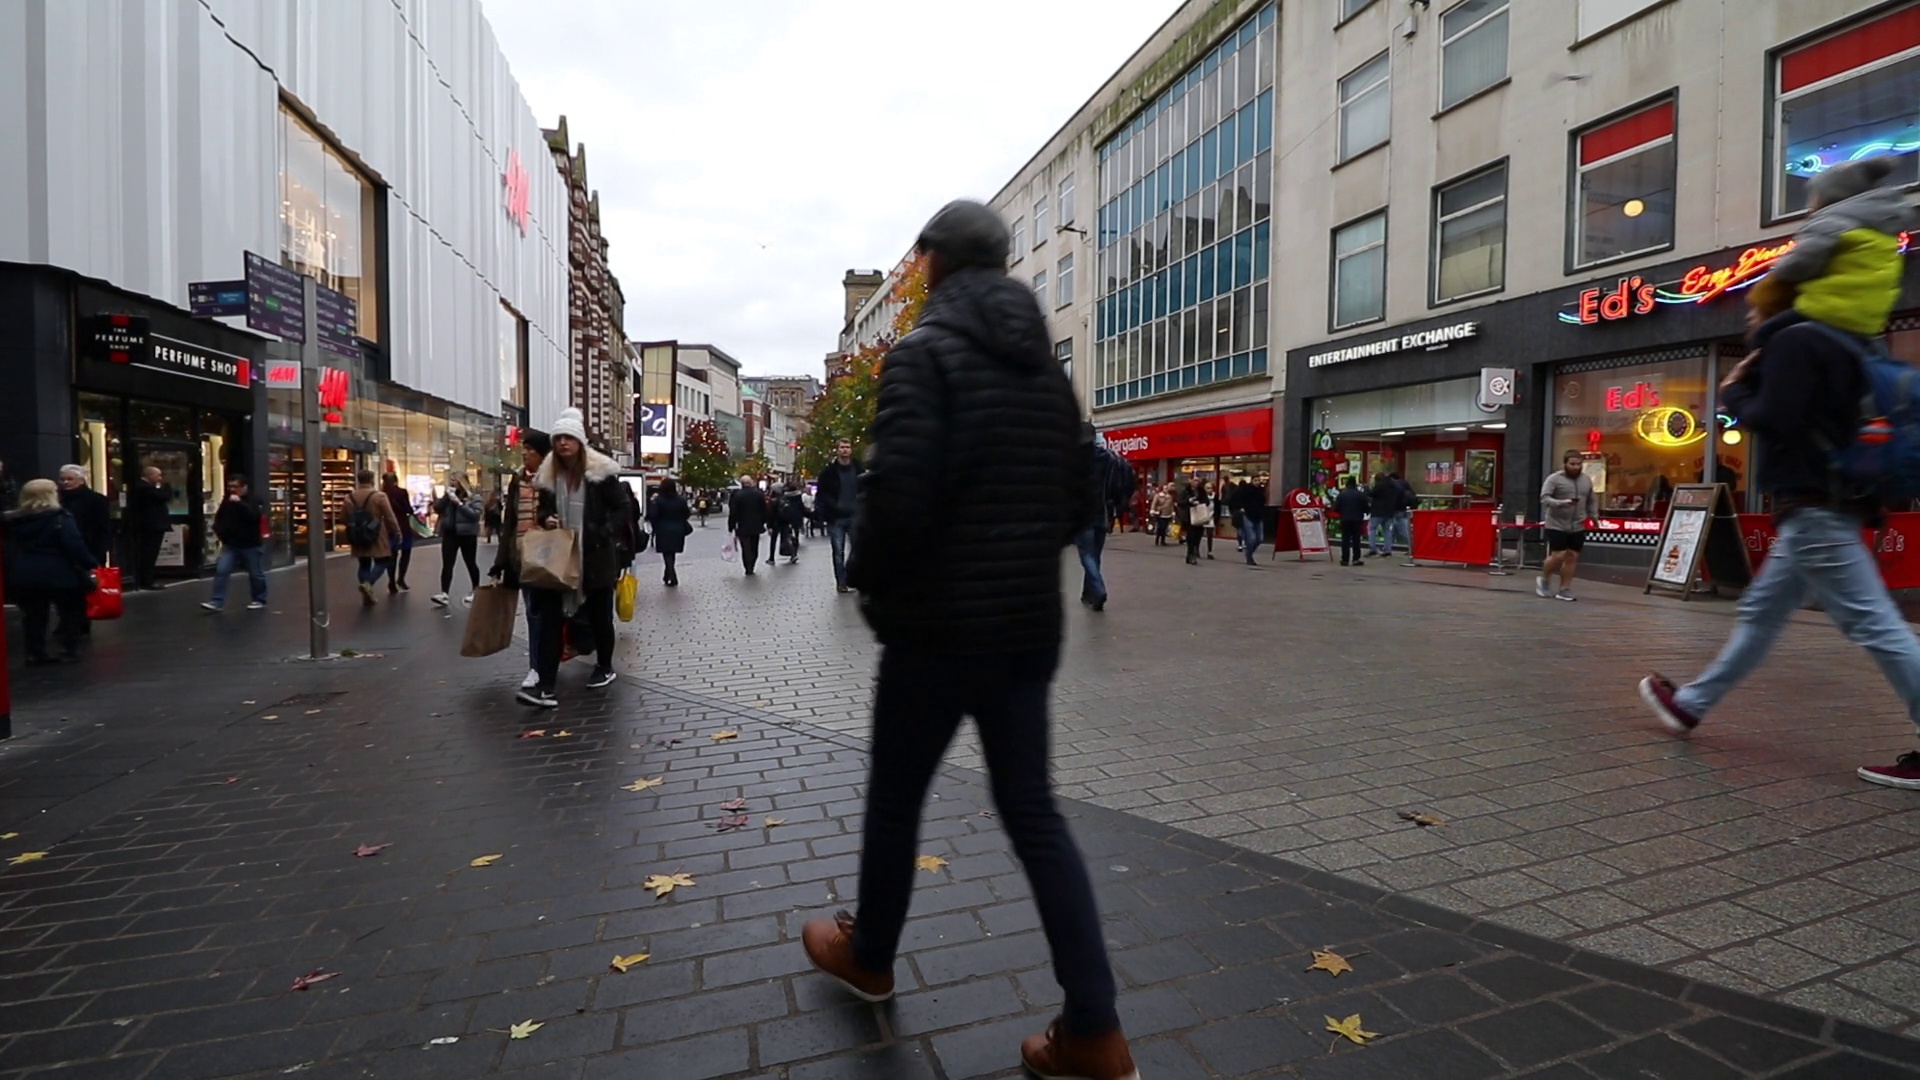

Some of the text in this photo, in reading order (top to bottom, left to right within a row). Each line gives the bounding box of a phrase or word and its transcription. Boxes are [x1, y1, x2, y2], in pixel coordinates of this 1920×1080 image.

[1578, 276, 1656, 325] Ed's
[95, 334, 144, 344] PERFUME
[1308, 322, 1476, 368] ENTERTAINMENT EXCHANGE
[155, 345, 238, 376] PERFUME SHOP
[1605, 381, 1661, 411] Ed's
[1107, 433, 1148, 456] bargains
[1438, 521, 1463, 538] Ed's
